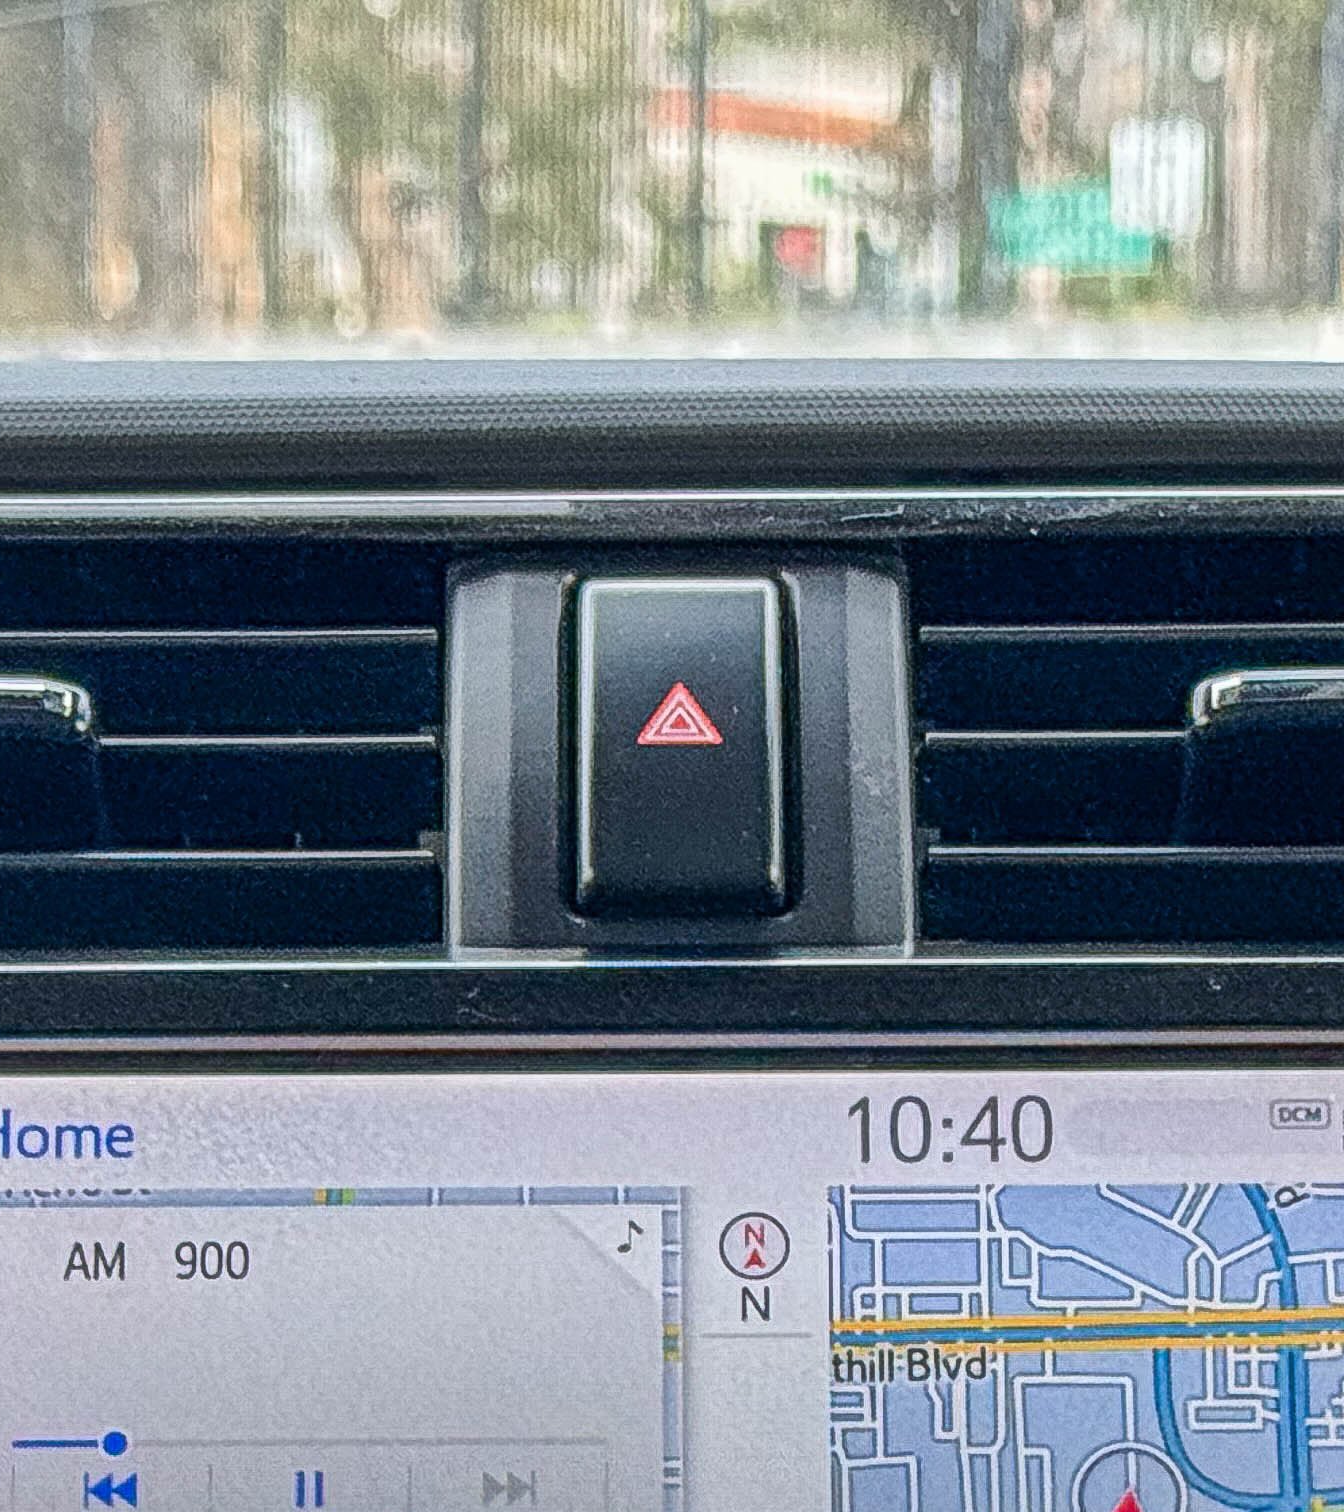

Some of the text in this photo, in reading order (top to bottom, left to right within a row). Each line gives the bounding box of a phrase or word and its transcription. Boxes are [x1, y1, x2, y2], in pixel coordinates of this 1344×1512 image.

[846, 1094, 1055, 1165] 10:40
[1278, 1106, 1322, 1123] DCM
[744, 1222, 765, 1249] N
[62, 1240, 251, 1282] AM 900
[741, 1285, 770, 1323] N
[832, 1345, 987, 1384] thill Blvd
